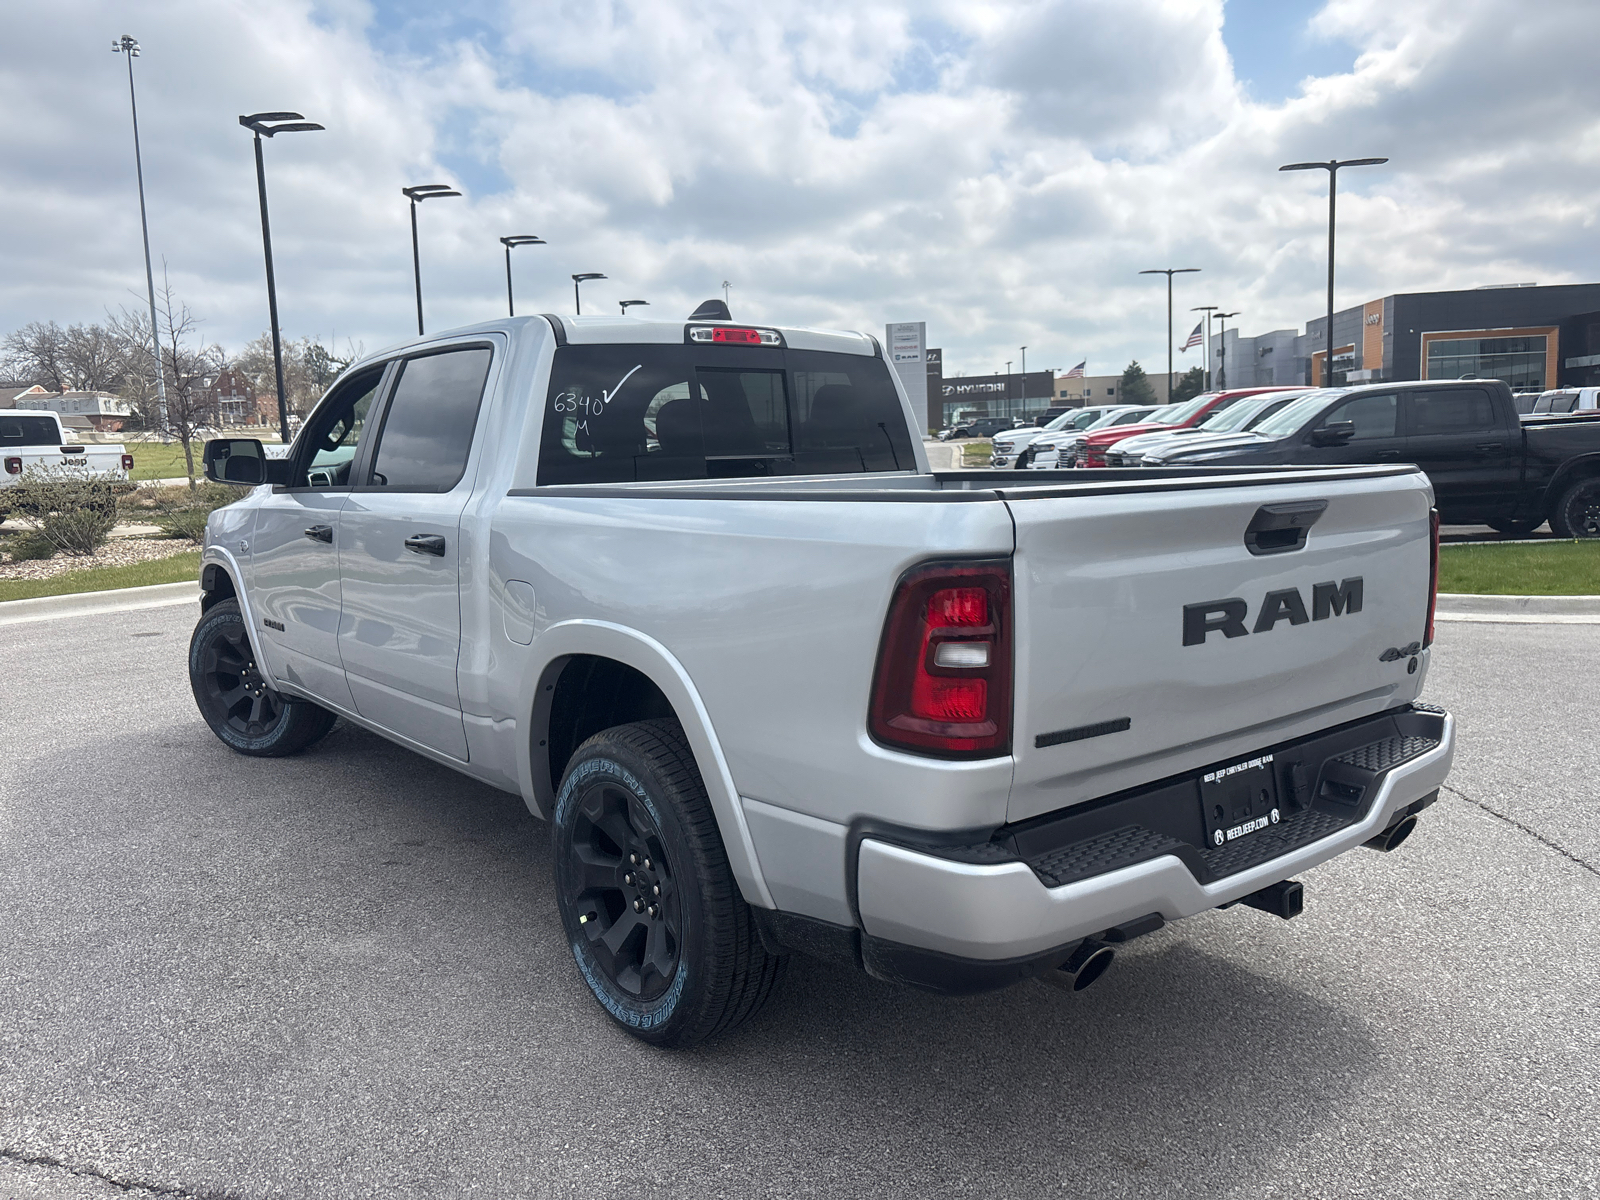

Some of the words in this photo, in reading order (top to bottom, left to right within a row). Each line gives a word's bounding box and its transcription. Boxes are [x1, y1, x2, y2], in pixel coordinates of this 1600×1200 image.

[956, 382, 1005, 395] HYUNDAI
[554, 392, 604, 415] 6340
[60, 456, 88, 467] Jeep
[1182, 575, 1364, 647] RAM
[1204, 773, 1215, 783] REED
[1216, 769, 1226, 779] JEEP
[1227, 762, 1248, 775] CHRYSLER
[1263, 754, 1274, 764] RAM
[556, 759, 615, 823] DUELER
[1226, 815, 1269, 841] REEDJEEP.COM
